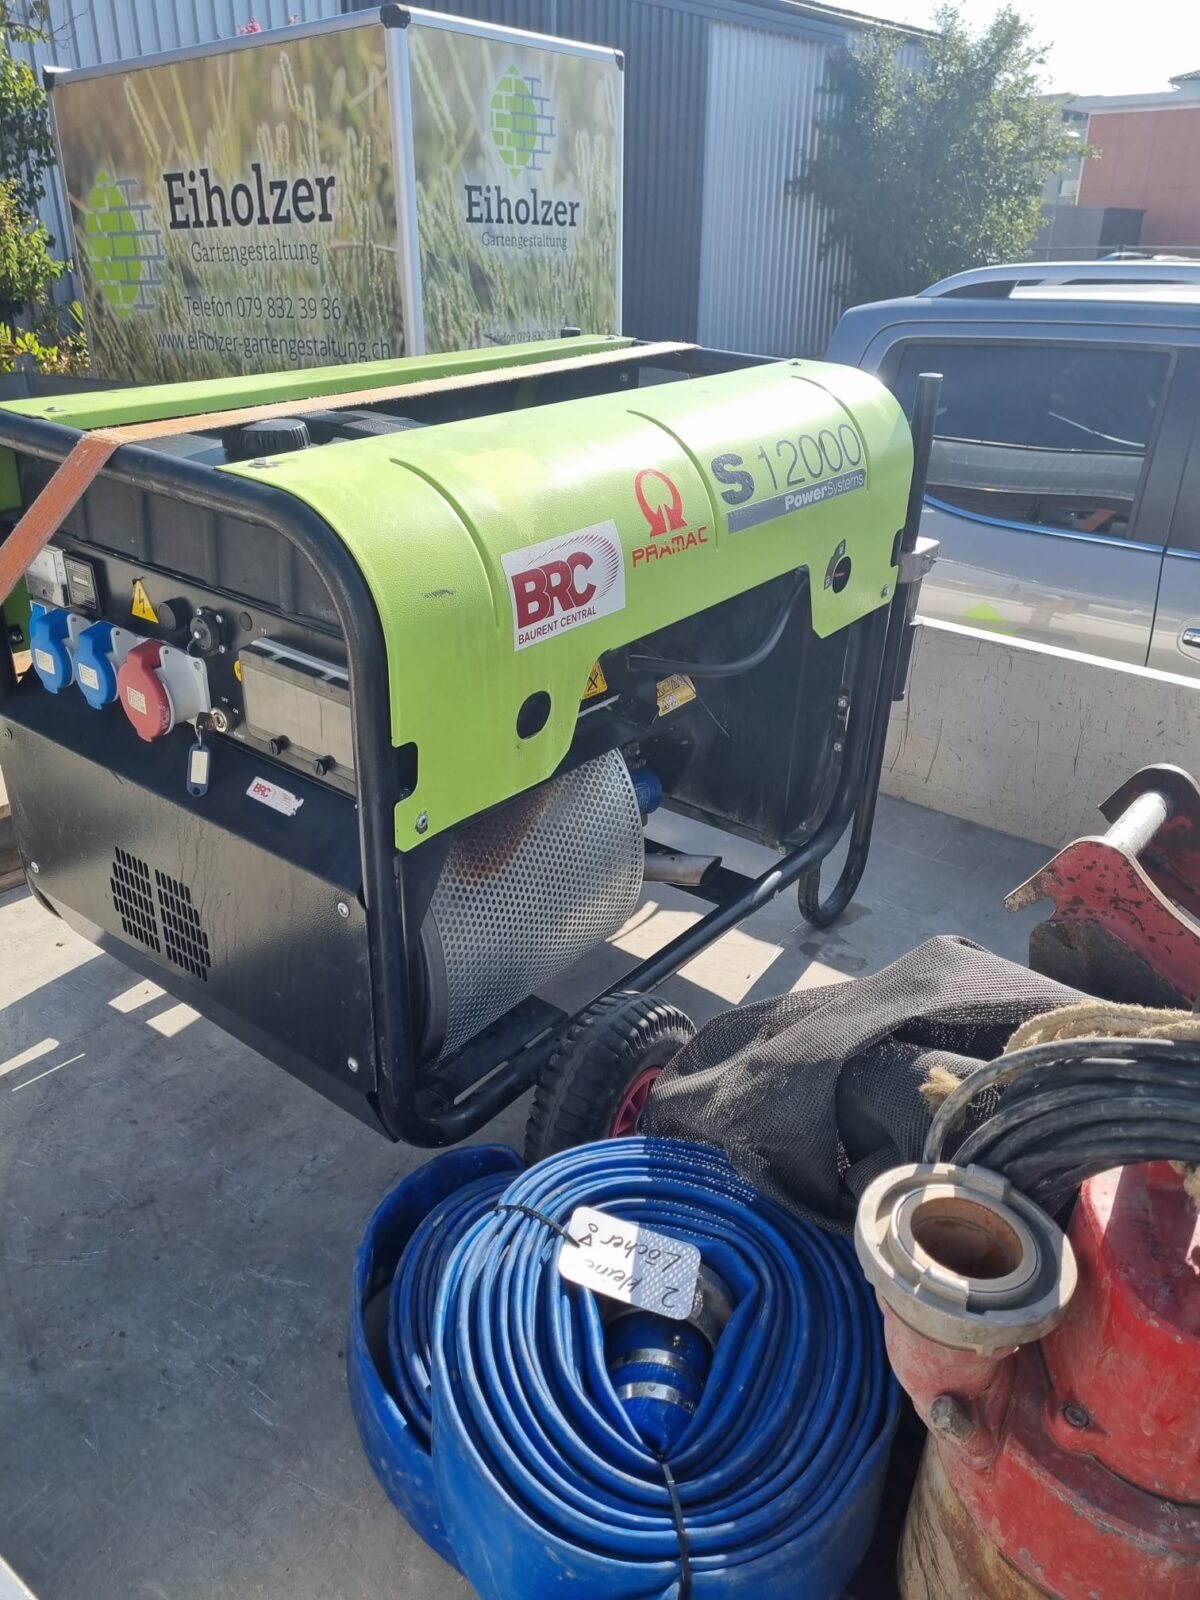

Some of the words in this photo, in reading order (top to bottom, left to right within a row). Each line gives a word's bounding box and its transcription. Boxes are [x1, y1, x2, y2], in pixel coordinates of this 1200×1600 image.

[162, 162, 336, 230] Eiholzer
[463, 184, 580, 227] Eiholzer
[190, 238, 320, 267] Gartengestaltung
[481, 231, 568, 251] Gartengestaltung
[184, 295, 233, 319] Telefon
[236, 296, 263, 319] 079
[267, 297, 294, 320] 832
[299, 298, 318, 320] 39
[322, 297, 342, 321] 36
[155, 330, 391, 363] www.eiholzer-gartengestaltung.ch
[710, 453, 755, 505] S
[757, 423, 862, 491] 12000
[784, 472, 864, 511] PowerSystems
[631, 525, 708, 569] PRAMAC
[510, 551, 597, 630] BRC
[518, 619, 559, 645] BAURENT
[560, 605, 597, 628] CENTRAL
[253, 782, 272, 798] BRC
[661, 1286, 680, 1308] 2
